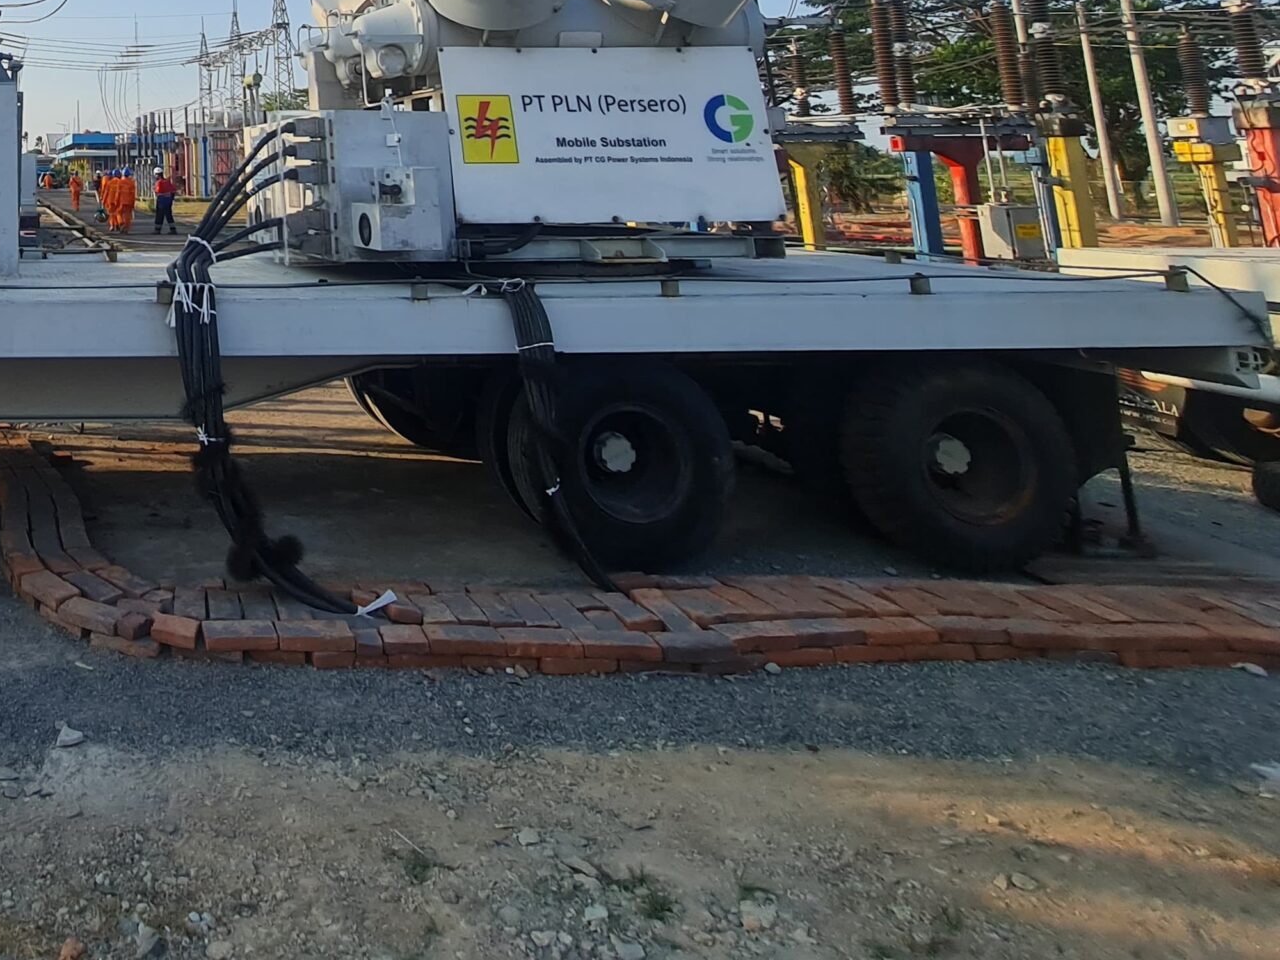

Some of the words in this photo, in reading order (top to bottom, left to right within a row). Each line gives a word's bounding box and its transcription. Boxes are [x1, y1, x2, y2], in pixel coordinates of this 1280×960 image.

[521, 95, 546, 113] PT
[551, 95, 593, 113] PLN
[597, 94, 687, 116] (Persero)
[556, 137, 597, 148] Mobile
[600, 137, 667, 148] Substation
[535, 156, 573, 164] Assembled
[573, 156, 583, 165] by
[584, 156, 594, 164] PT
[594, 156, 607, 164] CG
[607, 156, 629, 164] Power
[629, 156, 660, 165] Systems
[660, 156, 694, 164] Indonesia
